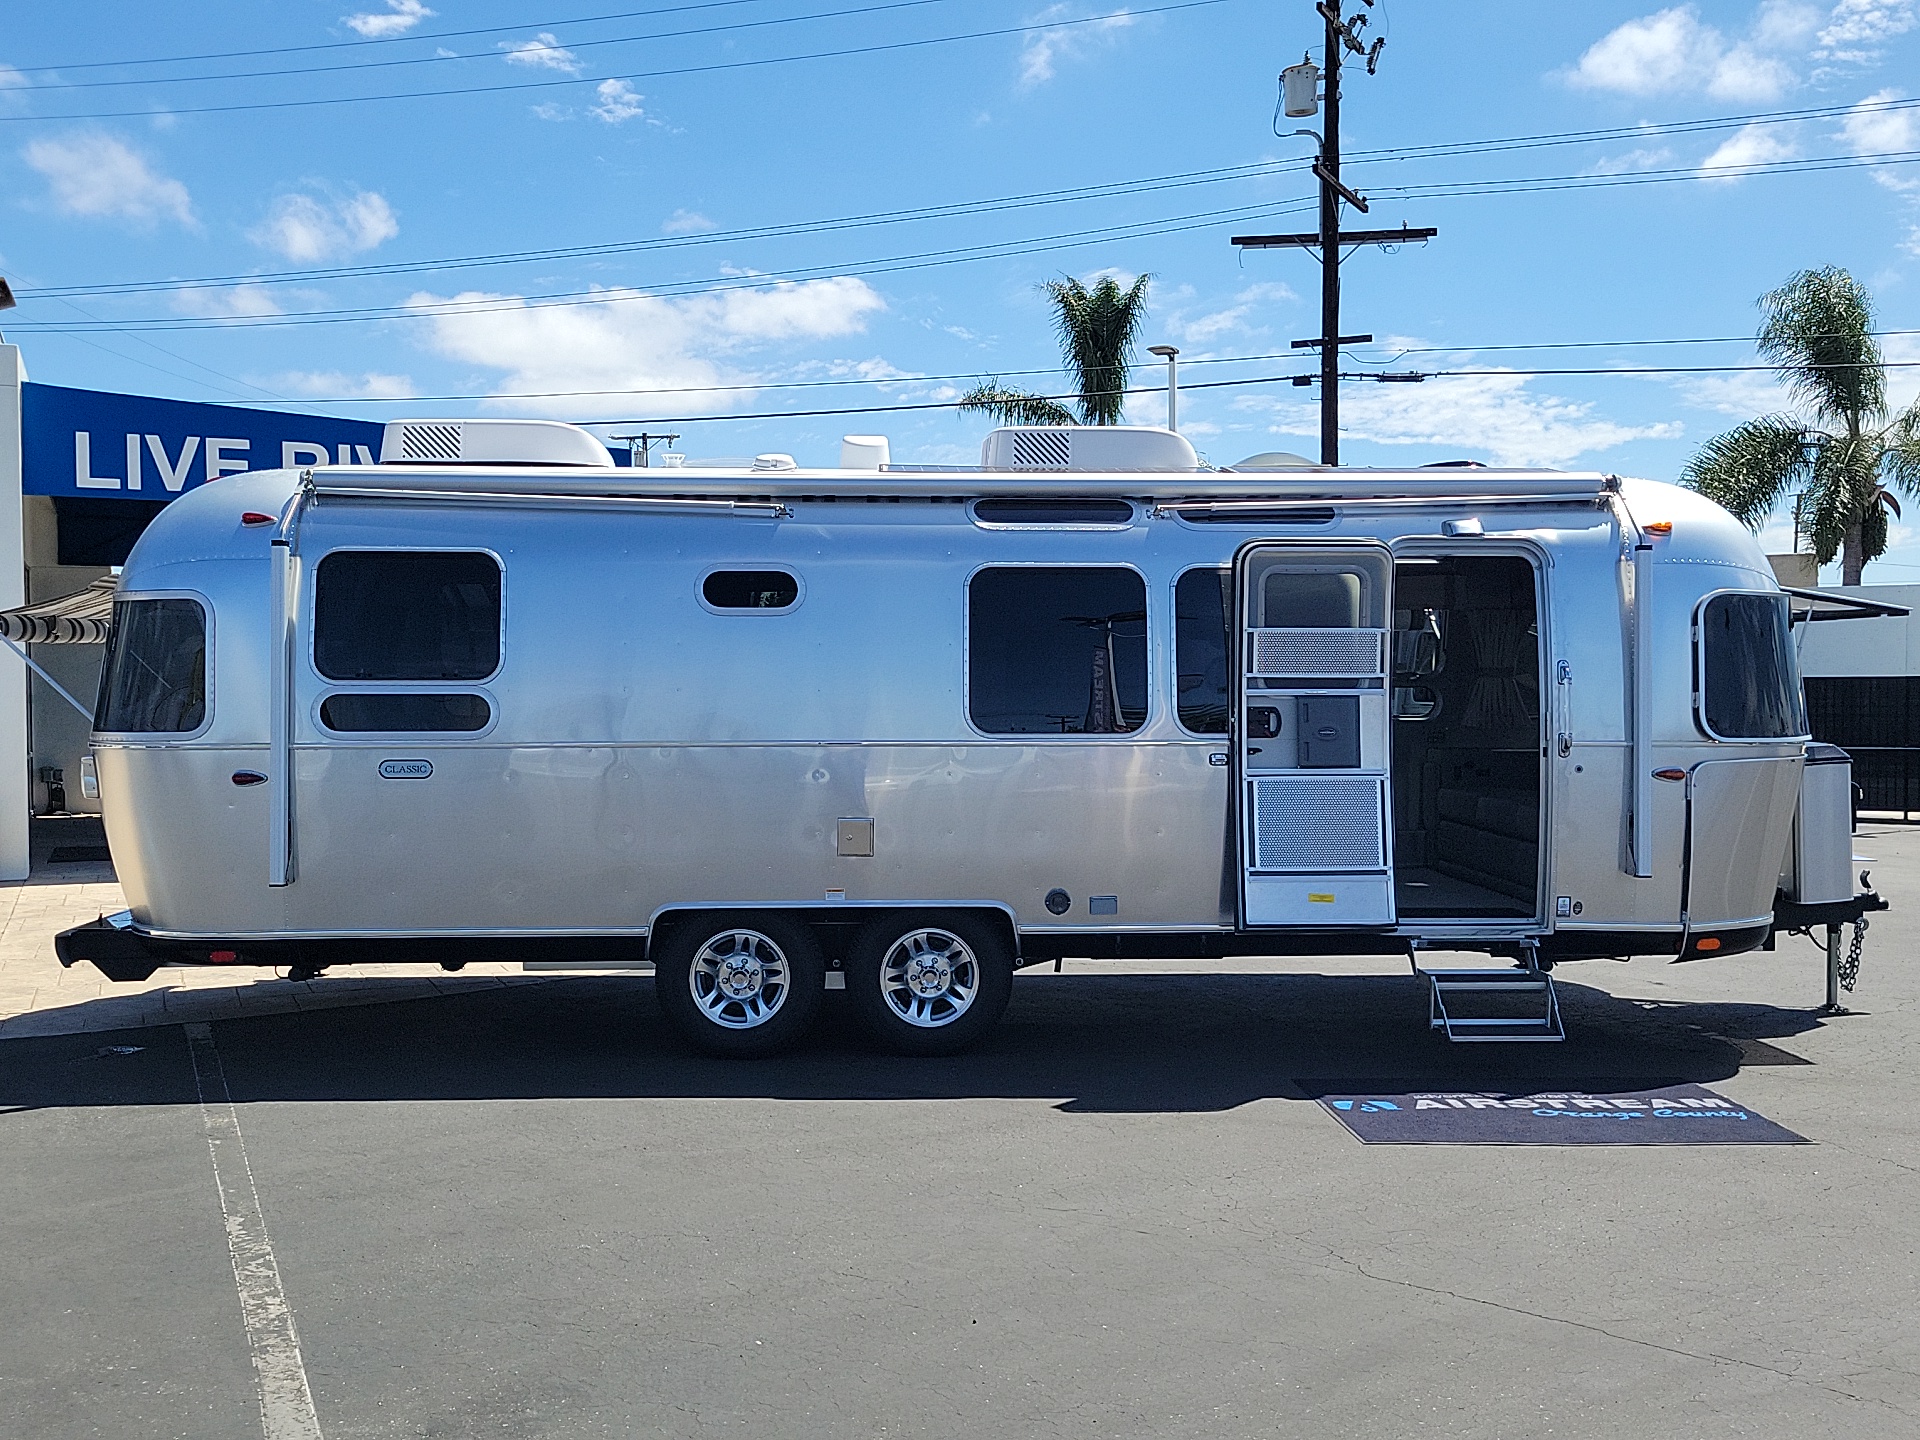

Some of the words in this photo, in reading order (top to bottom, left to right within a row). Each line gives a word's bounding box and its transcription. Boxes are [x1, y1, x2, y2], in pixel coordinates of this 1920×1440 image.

[75, 431, 250, 491] LIVE
[384, 765, 427, 774] CLASSIC
[1415, 1099, 1733, 1109] AIRSTREAM
[1532, 1108, 1645, 1121] Orange
[1652, 1108, 1748, 1121] County
